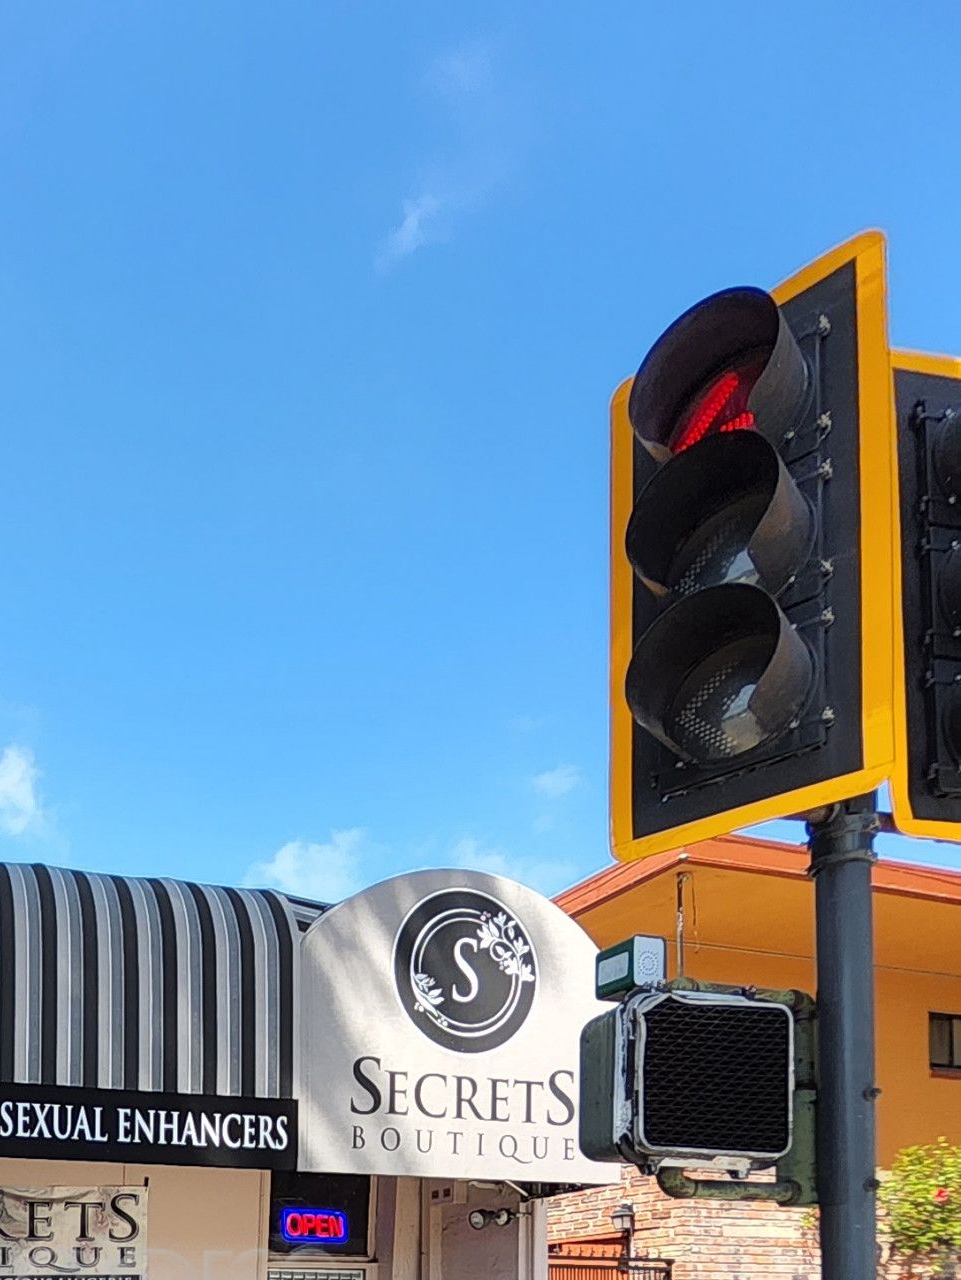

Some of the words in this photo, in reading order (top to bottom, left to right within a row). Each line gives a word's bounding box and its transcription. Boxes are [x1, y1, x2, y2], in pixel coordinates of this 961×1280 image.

[452, 937, 479, 1002] S
[350, 1056, 575, 1126] SECRETS
[0, 1101, 108, 1142] SEXUAL
[117, 1107, 289, 1151] ENHANCERS
[351, 1125, 575, 1164] BOUTIQUE
[286, 1212, 344, 1238] OPEN
